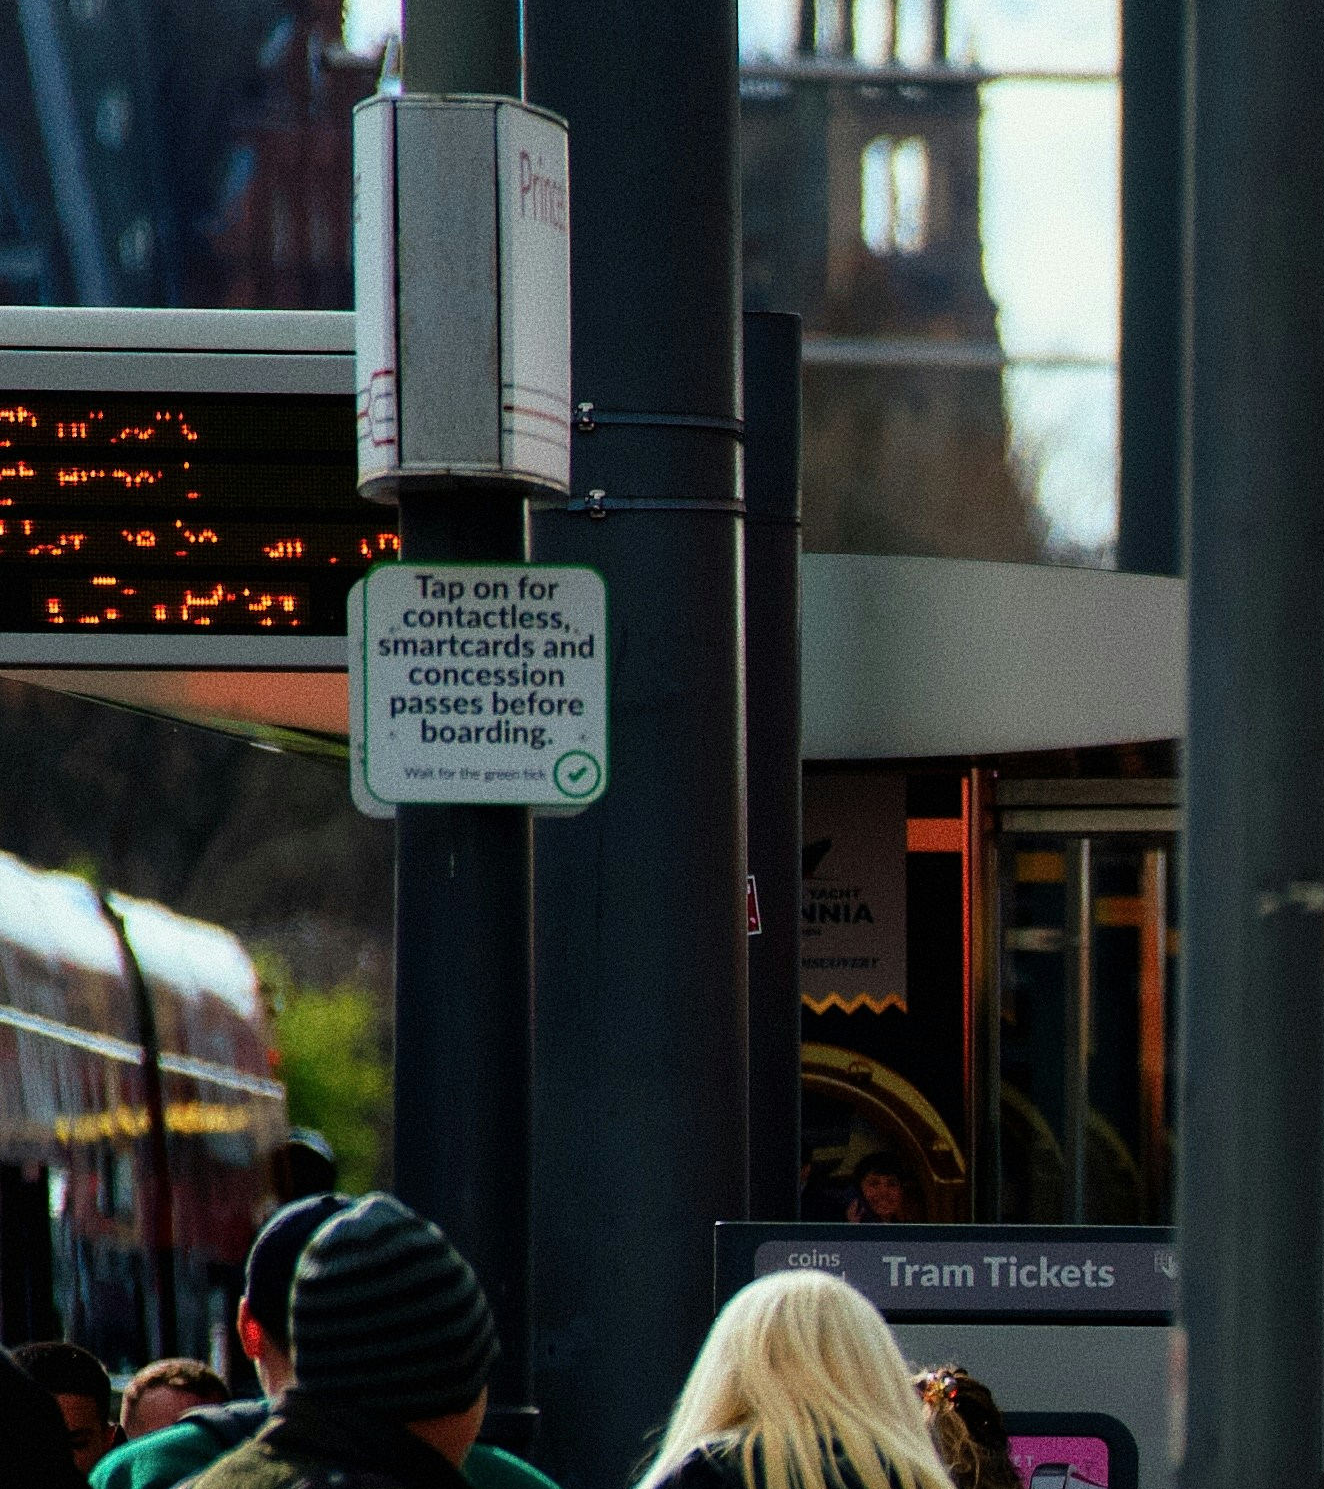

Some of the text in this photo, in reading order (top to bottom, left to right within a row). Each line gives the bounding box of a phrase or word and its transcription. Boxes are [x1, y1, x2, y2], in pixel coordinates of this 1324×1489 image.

[415, 574, 559, 603] Tap on for
[402, 604, 571, 633] contactless,
[378, 633, 595, 659] smartcards and
[408, 662, 565, 687] concession
[390, 691, 585, 719] passes before
[420, 718, 553, 750] boarding.
[404, 766, 546, 783] Wait for the green tick
[787, 1248, 841, 1267] coins
[882, 1255, 1116, 1289] Tram Tickets
